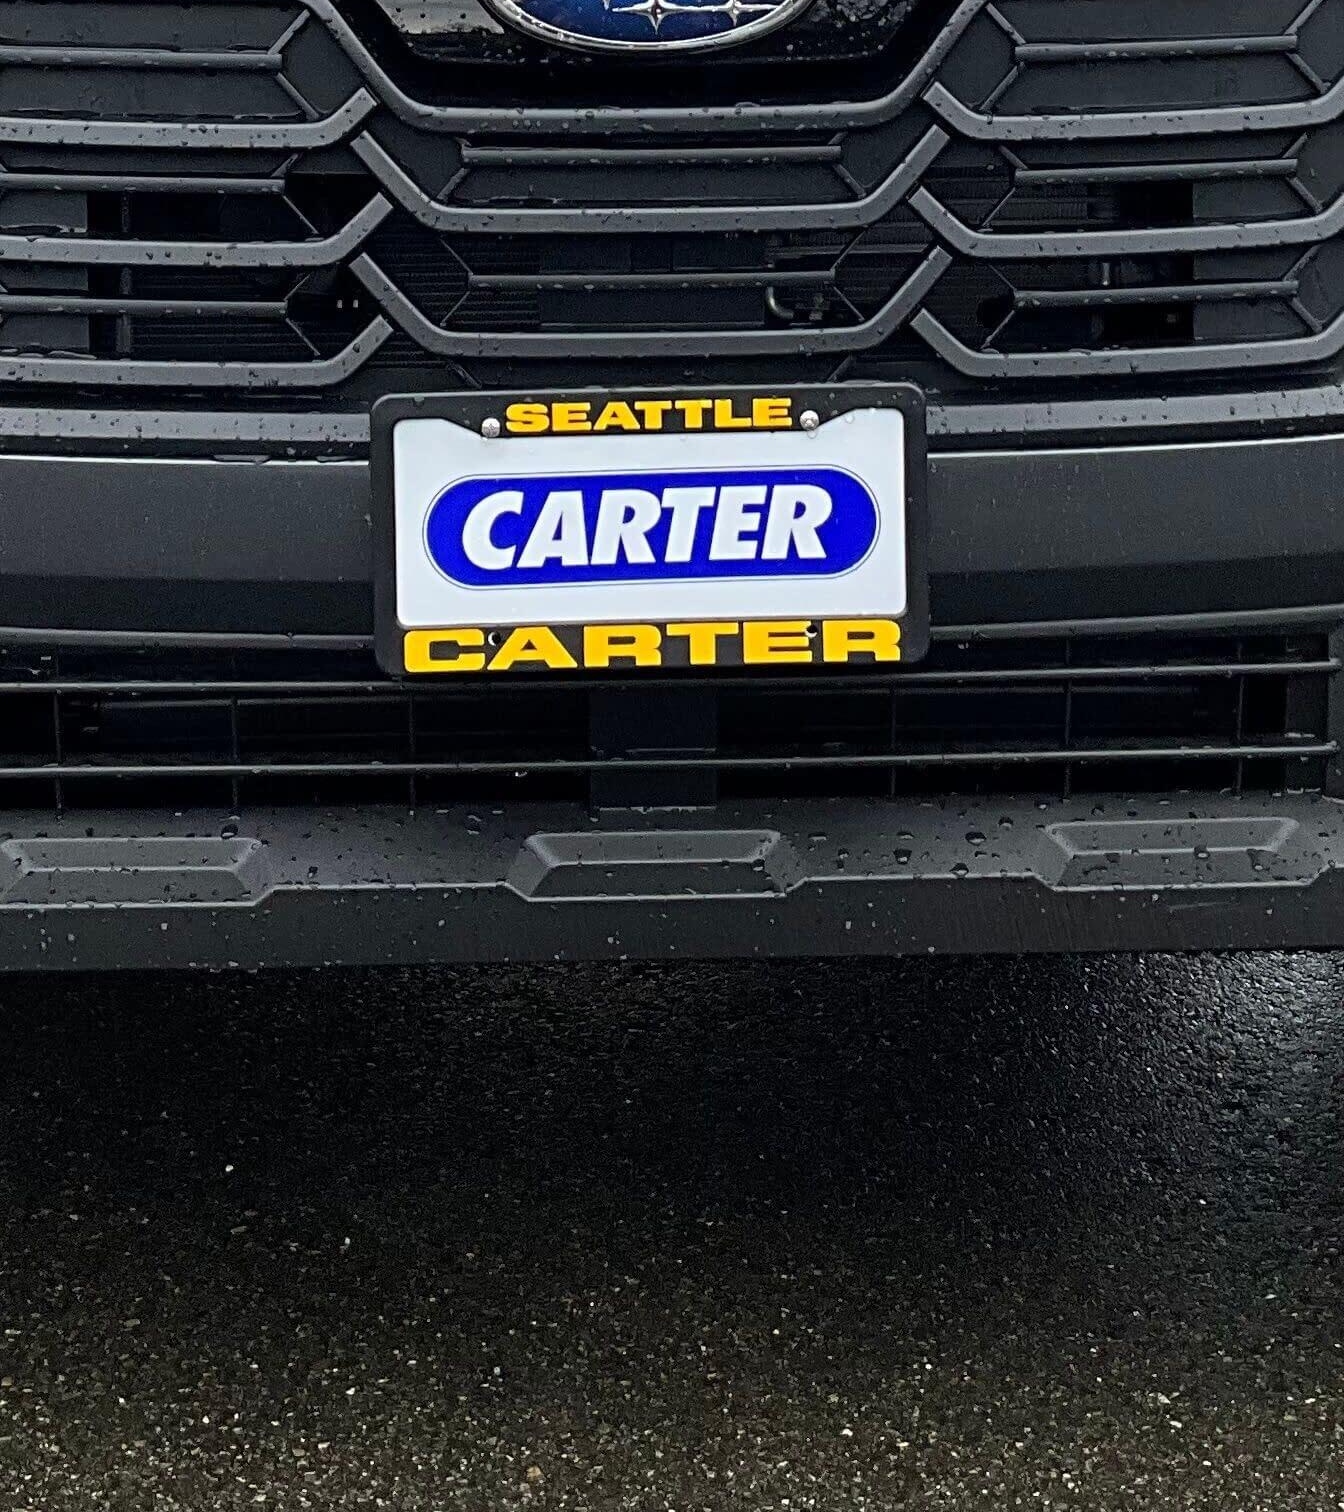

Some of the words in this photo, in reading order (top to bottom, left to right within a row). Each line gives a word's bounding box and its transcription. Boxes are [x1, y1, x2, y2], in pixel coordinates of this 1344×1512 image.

[505, 397, 793, 433] SEATTLE
[462, 483, 833, 571] CARTER
[403, 619, 902, 673] CARTER
